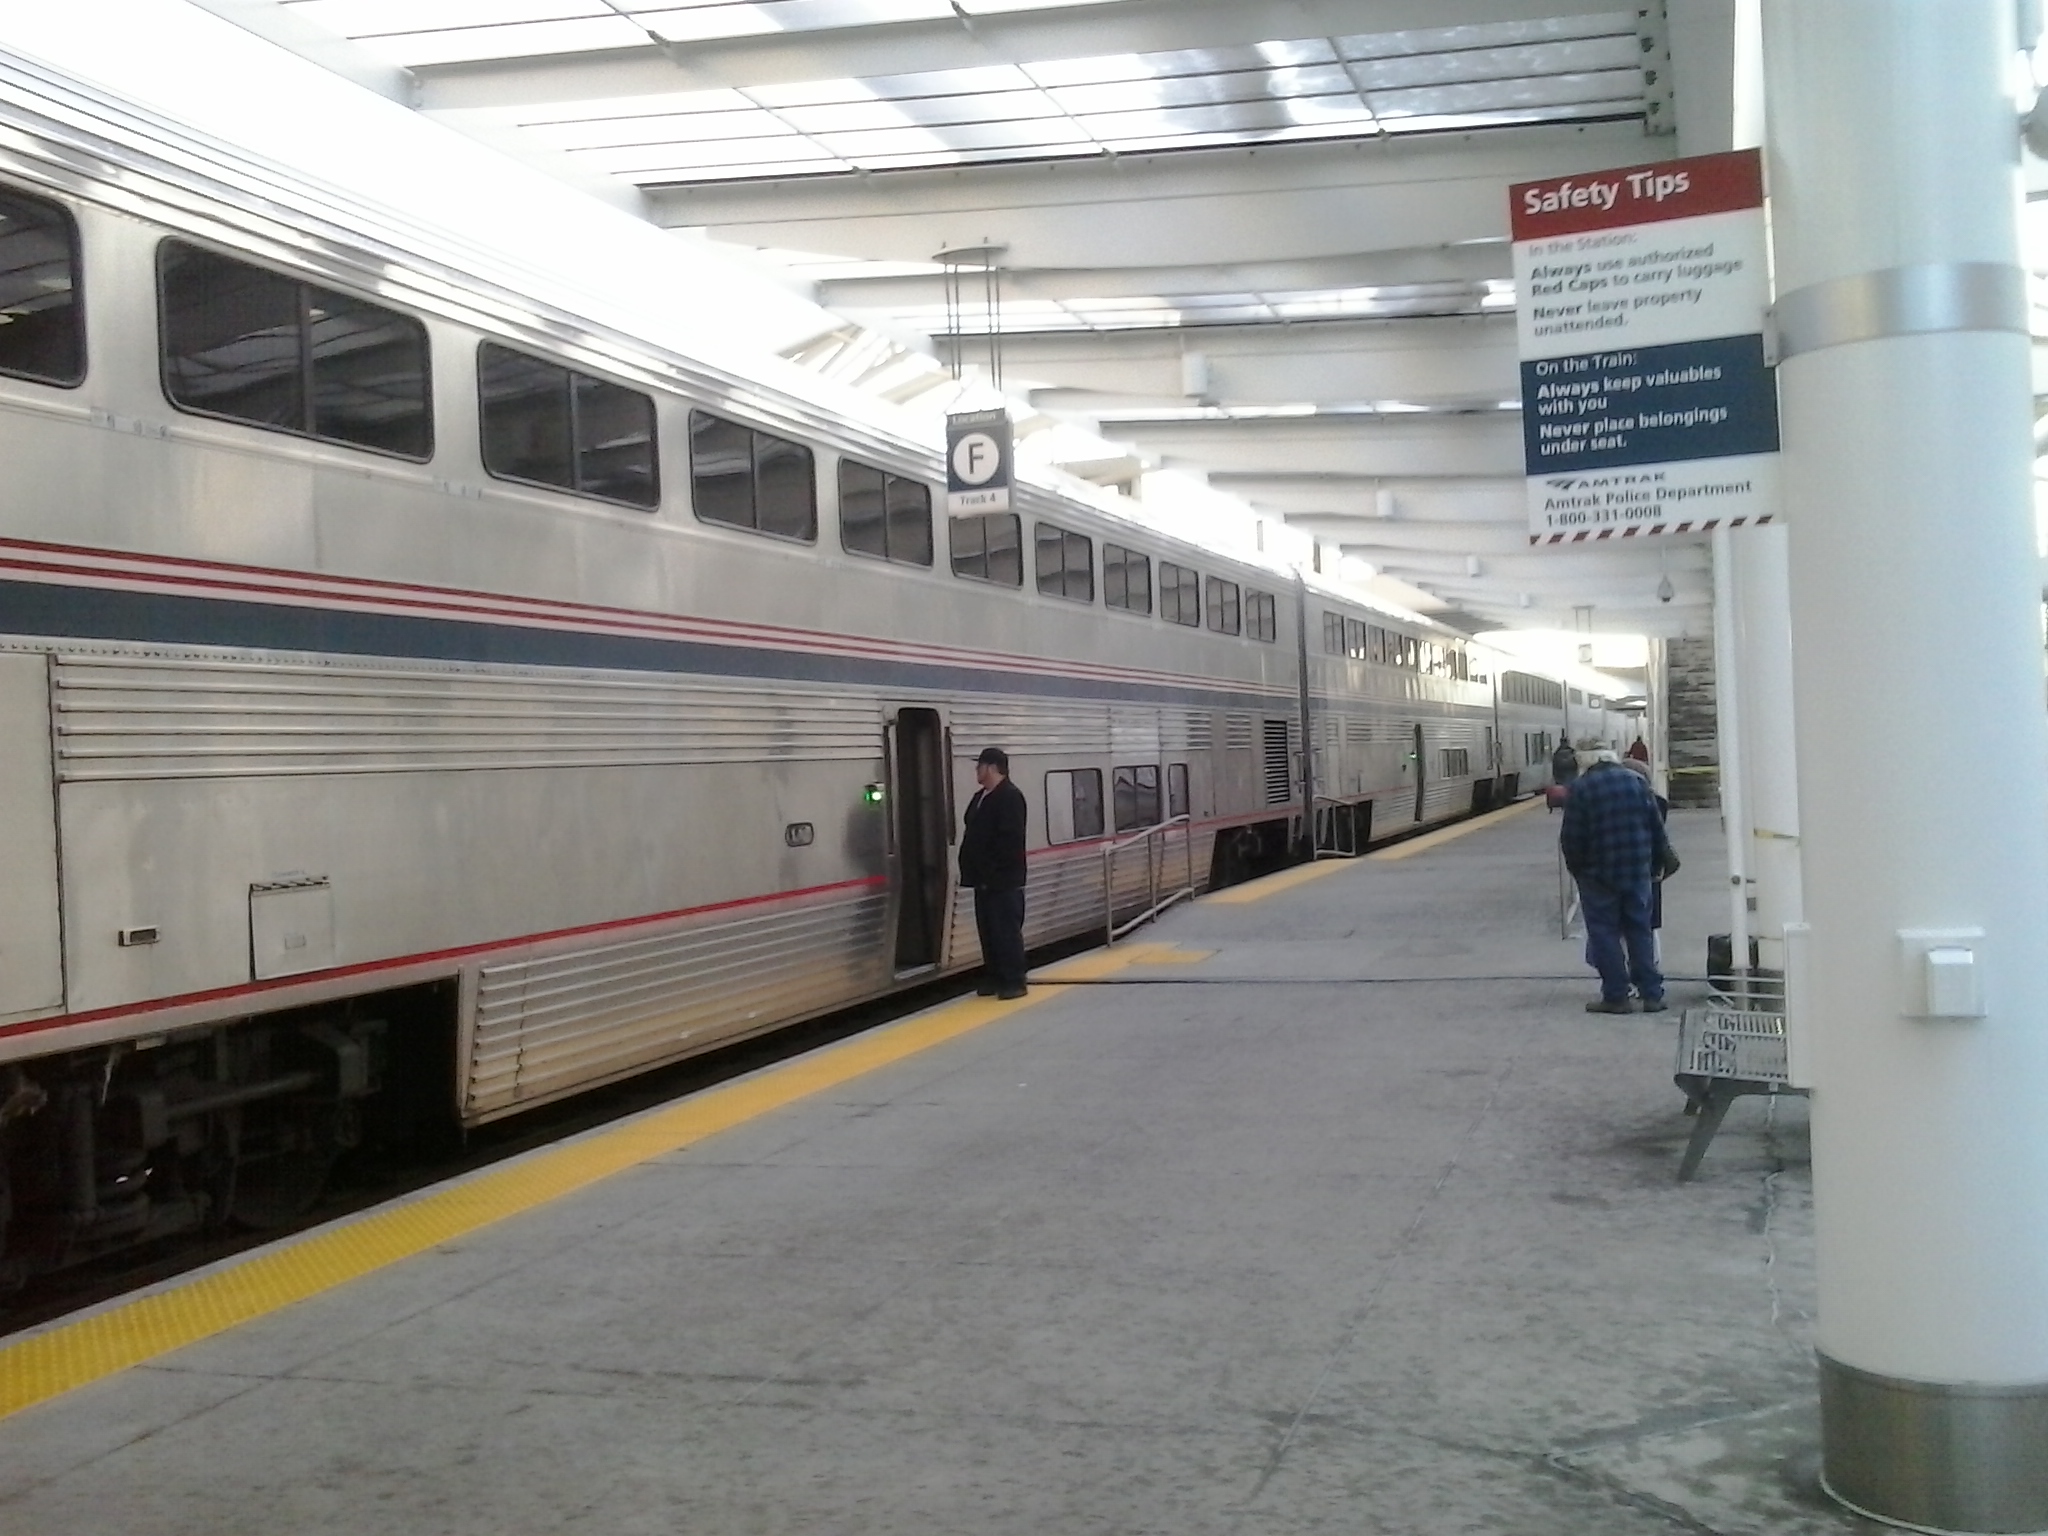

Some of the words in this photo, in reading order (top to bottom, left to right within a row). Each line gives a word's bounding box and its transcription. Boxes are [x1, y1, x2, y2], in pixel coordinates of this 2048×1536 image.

[1524, 180, 1620, 215] Safety
[1625, 169, 1691, 202] Tips
[1529, 245, 1544, 258] In
[1547, 240, 1575, 254] the
[1531, 261, 1591, 280] Always
[1597, 258, 1622, 271] use
[1628, 243, 1714, 267] authorized
[1532, 281, 1562, 297] Red
[1568, 276, 1608, 294] Caps
[1613, 274, 1629, 286] to
[1634, 267, 1673, 285] carry
[1677, 259, 1743, 280] luggage
[1533, 303, 1582, 321] Never
[1587, 297, 1628, 314] leave
[1633, 287, 1703, 311] property
[1534, 313, 1629, 337] unattended.
[1535, 361, 1559, 377] On
[1563, 357, 1590, 374] the
[1592, 351, 1637, 371] Train:
[1537, 379, 1599, 400] Always
[1603, 375, 1642, 394] keep
[1646, 364, 1722, 388] valuables
[1537, 400, 1574, 417] with
[1577, 396, 1608, 417] you
[1540, 420, 1590, 439] Never
[1594, 415, 1634, 435] place
[1639, 405, 1728, 430] belongings
[968, 442, 983, 474] F
[1541, 437, 1587, 456] under
[1590, 434, 1627, 451] seat.
[1545, 492, 1601, 511] Amtrak
[1606, 488, 1650, 506] Police
[1656, 480, 1752, 502] Department
[1577, 471, 1665, 490] AMTRAK
